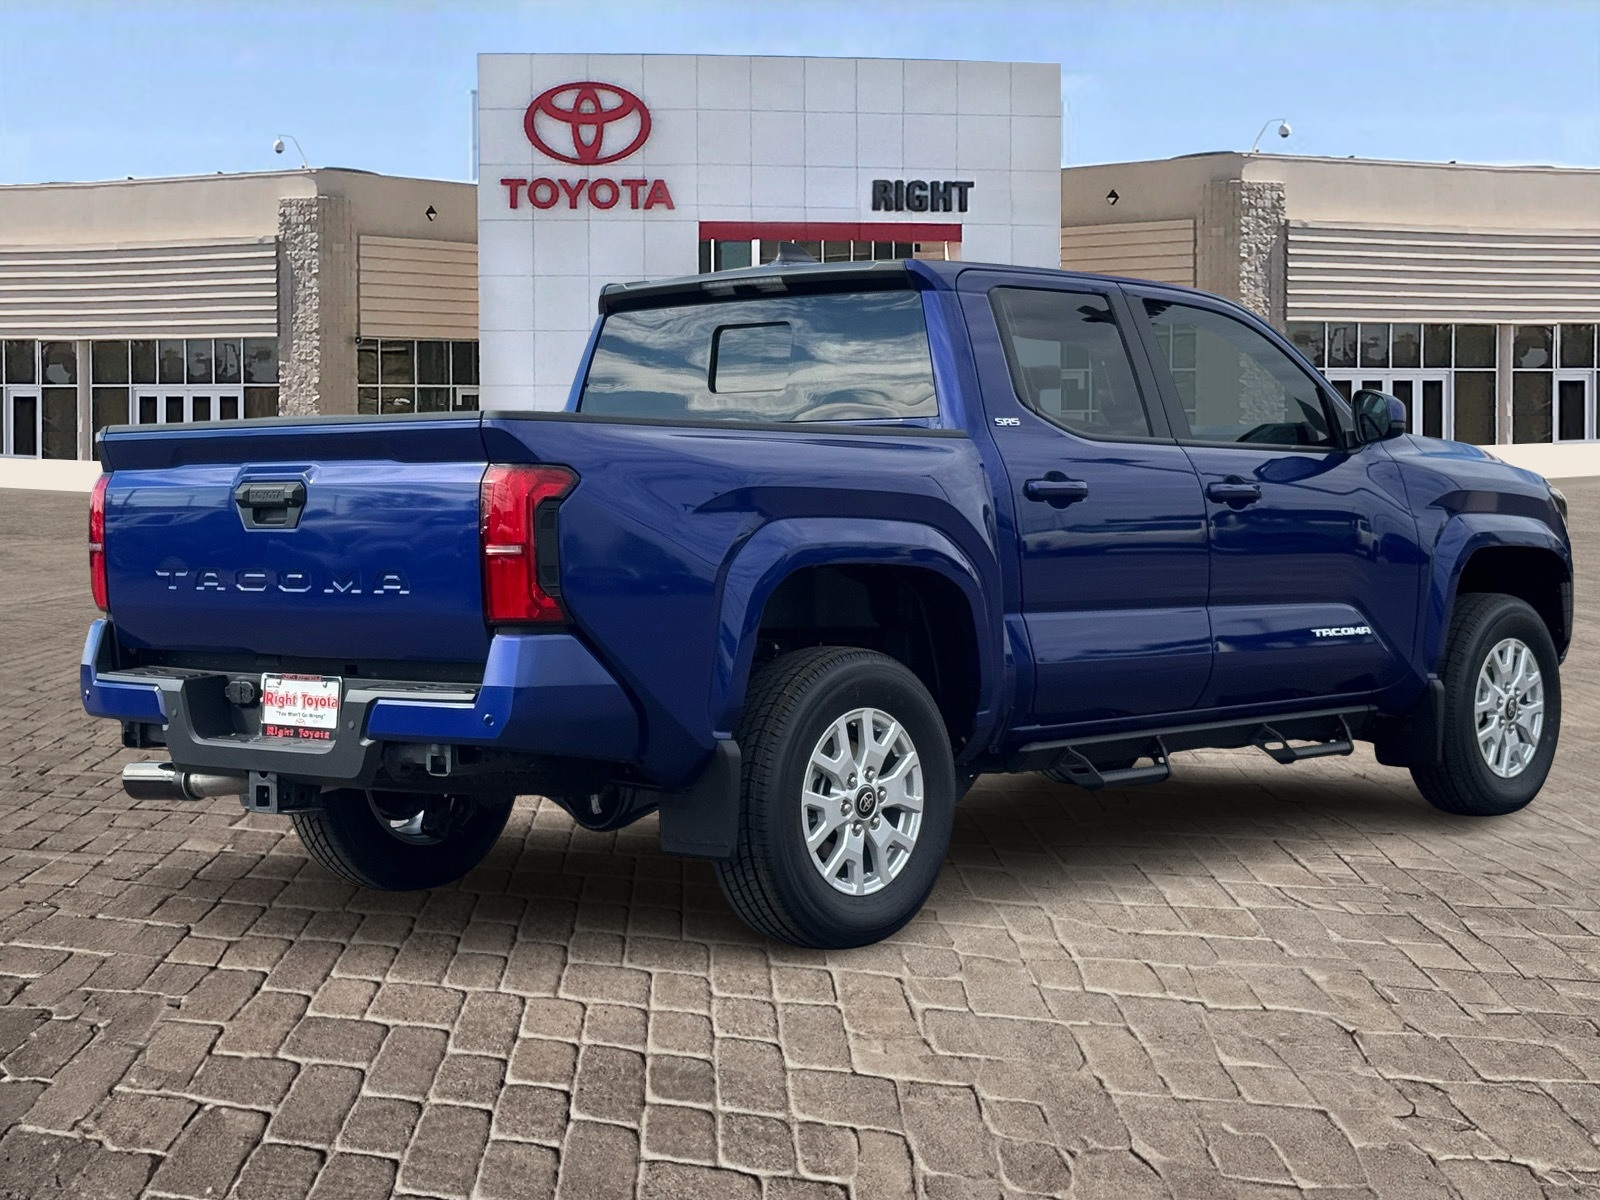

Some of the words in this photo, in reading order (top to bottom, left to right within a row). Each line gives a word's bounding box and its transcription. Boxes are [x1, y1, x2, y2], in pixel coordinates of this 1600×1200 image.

[500, 178, 676, 210] TOYOTA
[871, 179, 975, 213] RIGHT
[250, 490, 283, 500] TOYOTA
[155, 568, 410, 594] TACOMA
[1310, 626, 1372, 637] TACOMA
[264, 691, 297, 709] Right
[301, 693, 338, 711] Toyota
[266, 725, 294, 738] Right
[299, 727, 330, 739] Toyota
